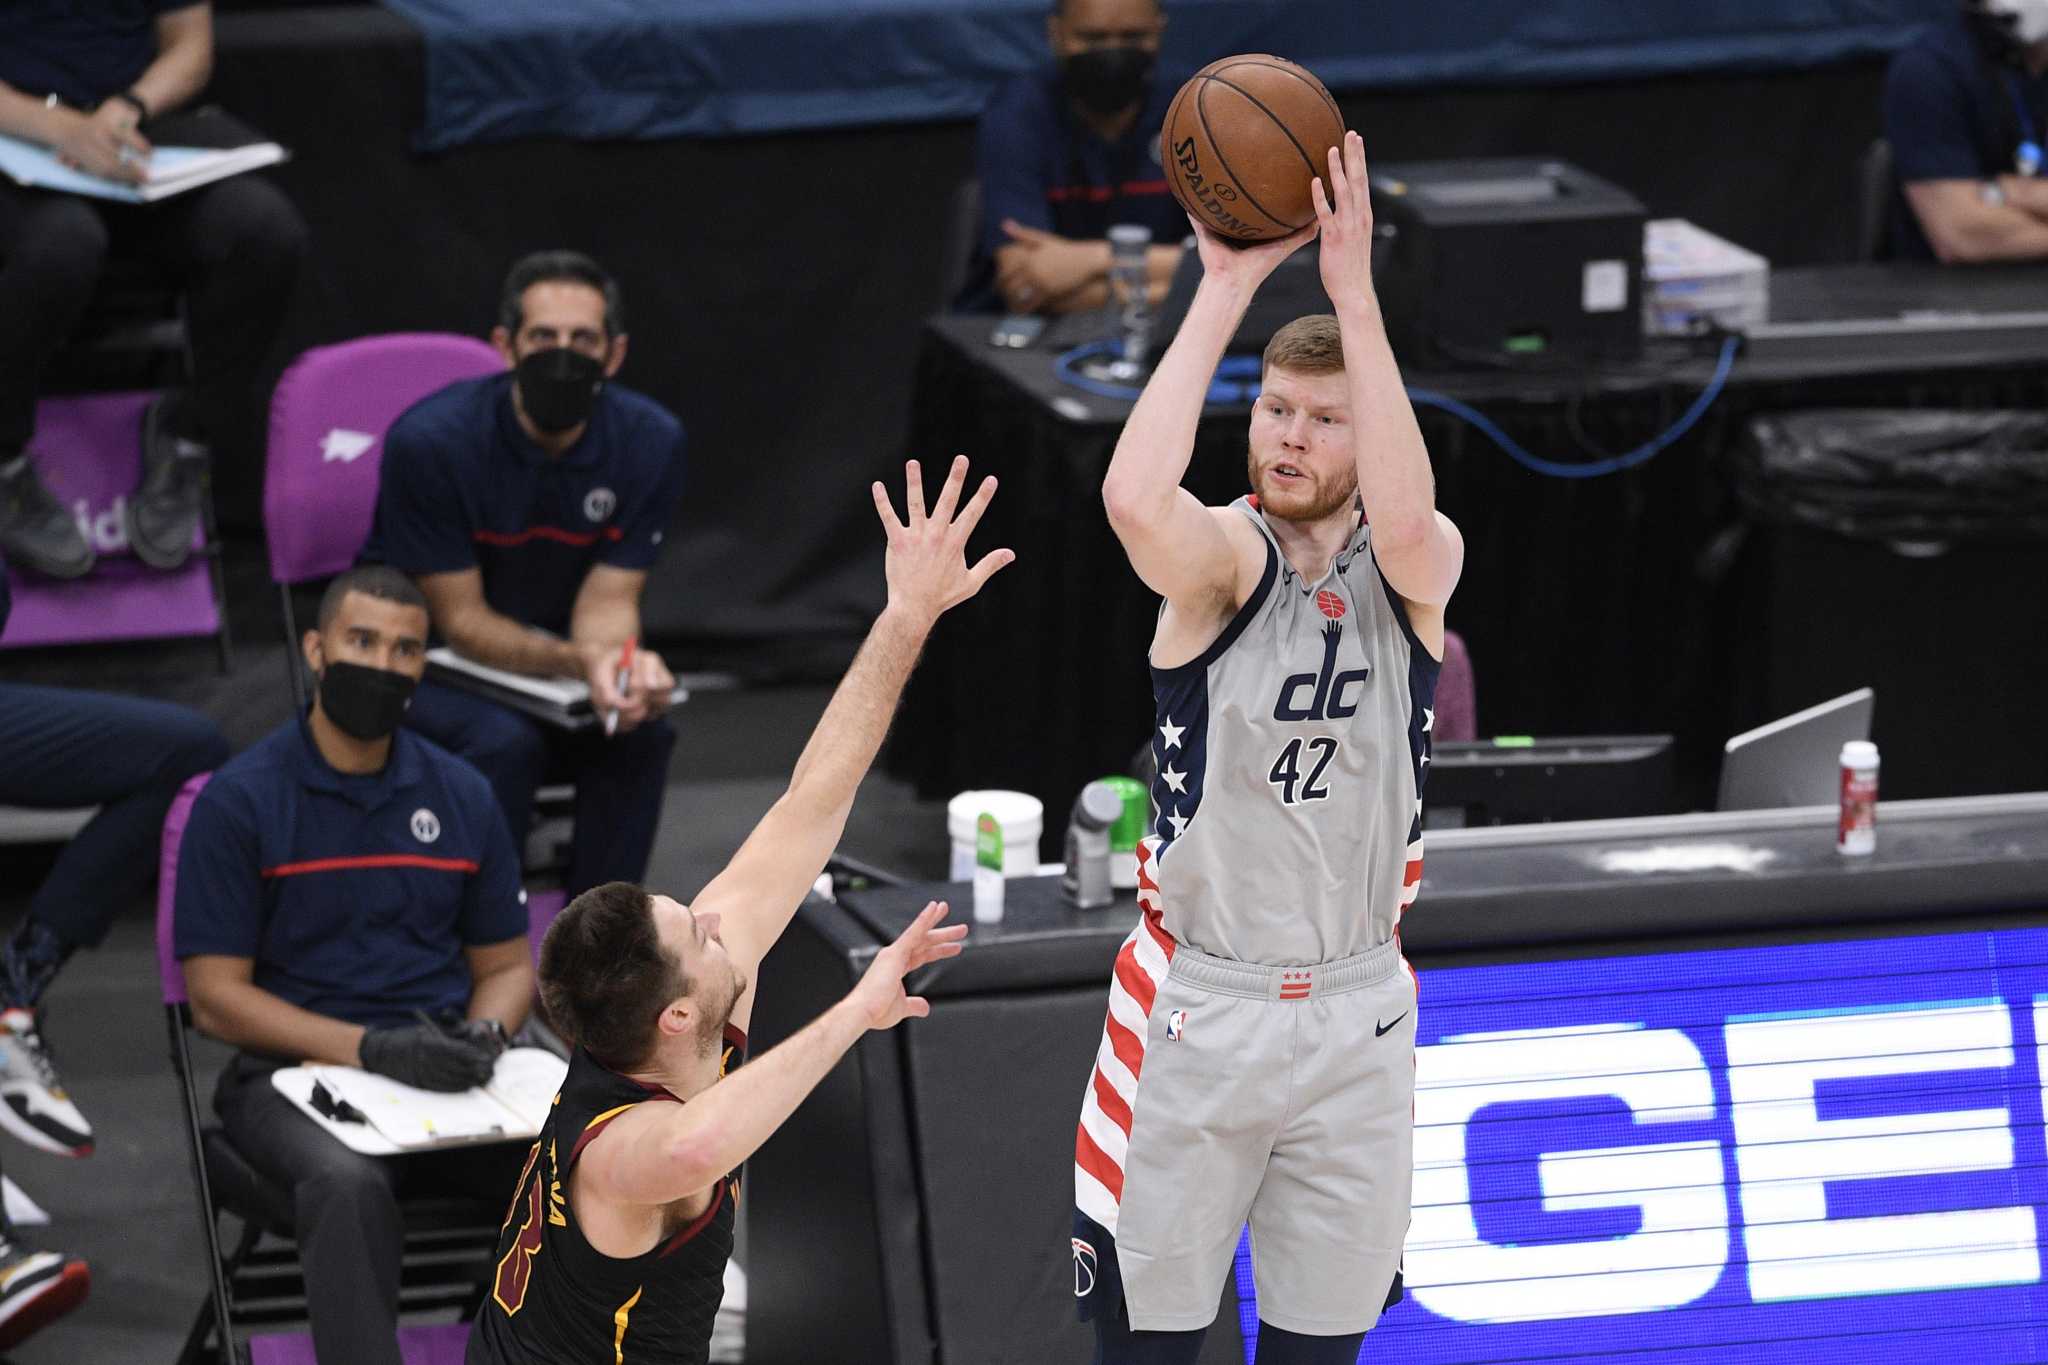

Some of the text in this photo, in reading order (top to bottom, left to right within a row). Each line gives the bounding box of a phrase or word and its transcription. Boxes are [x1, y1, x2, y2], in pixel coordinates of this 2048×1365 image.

[1174, 136, 1264, 237] SPALDING
[1268, 736, 1339, 805] 42
[1402, 993, 2048, 1325] GE
